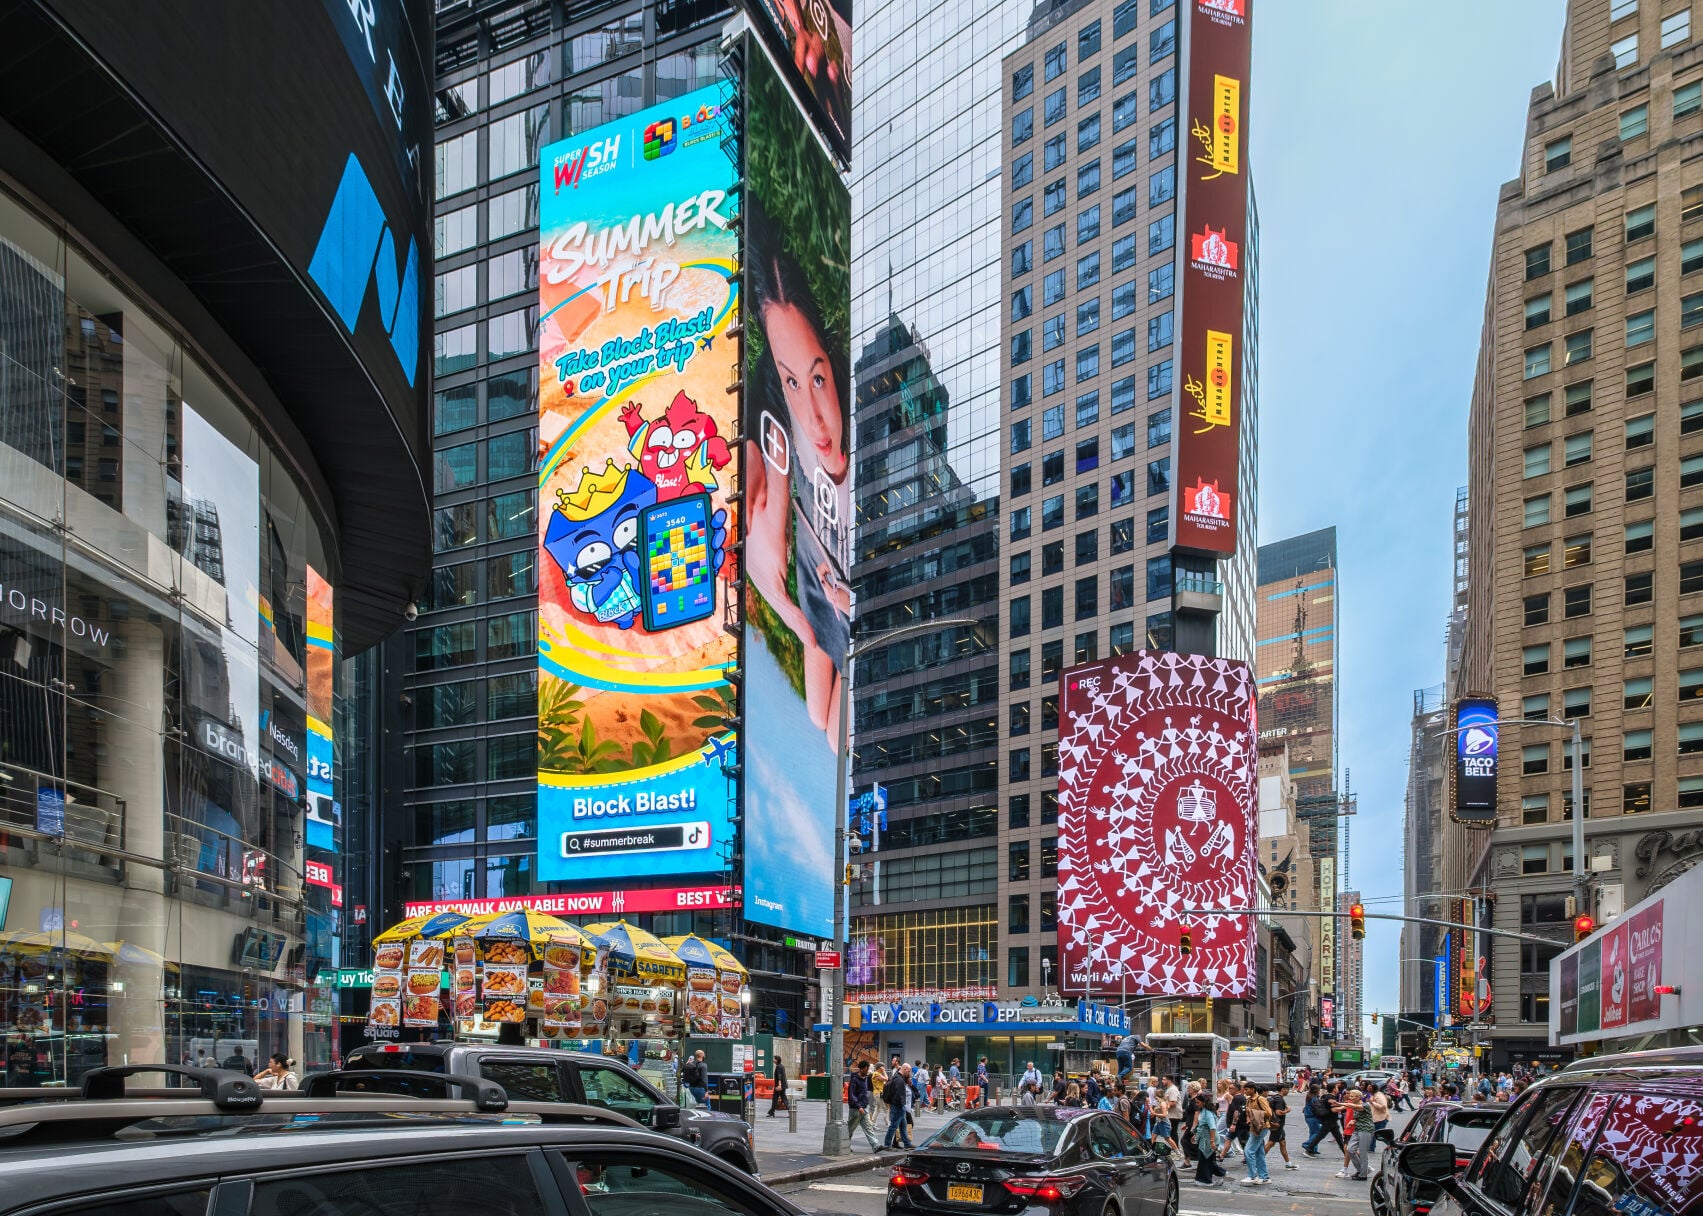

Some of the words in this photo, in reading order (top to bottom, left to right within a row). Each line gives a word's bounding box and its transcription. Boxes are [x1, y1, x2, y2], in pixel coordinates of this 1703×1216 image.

[1198, 6, 1245, 25] MAHARASHTRA
[1223, 88, 1231, 163] MAHARASHTRA
[554, 149, 581, 166] SUPER
[1191, 117, 1223, 180] Visit
[582, 161, 617, 180] SEASON
[548, 190, 728, 284] SUMMER
[1191, 261, 1237, 278] MAHARASHTRA
[556, 350, 600, 381] Take
[601, 328, 653, 367] Block
[654, 306, 714, 344] Blast!
[580, 371, 606, 393] on
[606, 357, 655, 396] your
[656, 340, 694, 372] trip
[1216, 343, 1224, 415] MAHARASHTRA
[1184, 374, 1216, 434] Visit
[666, 516, 686, 528] 3540
[1183, 514, 1230, 528] MAHARASHTRA
[1195, 522, 1218, 531] TOURISM
[1079, 676, 1101, 690] REC
[269, 722, 299, 762] Nasdaq
[1463, 757, 1494, 767] TACO
[1465, 767, 1495, 777] BELL
[573, 794, 631, 818] Block
[636, 787, 696, 812] Blast!
[583, 834, 655, 849] #summerbreak
[567, 897, 604, 911] NOW
[677, 891, 712, 906] BEST
[754, 895, 784, 911] Instagram
[1322, 923, 1332, 987] CARTER
[637, 961, 683, 977] SABRETT
[1071, 972, 1099, 983] Warli
[1101, 972, 1120, 982] Art
[861, 1002, 888, 1023] NEW
[890, 1002, 925, 1023] YORK
[930, 1003, 977, 1023] POLICE
[983, 1001, 1023, 1023] DEPT
[1041, 999, 1069, 1007] AT&T
[1091, 1003, 1105, 1025] YORK
[1104, 1006, 1119, 1027] POLICE
[363, 1027, 400, 1042] square
